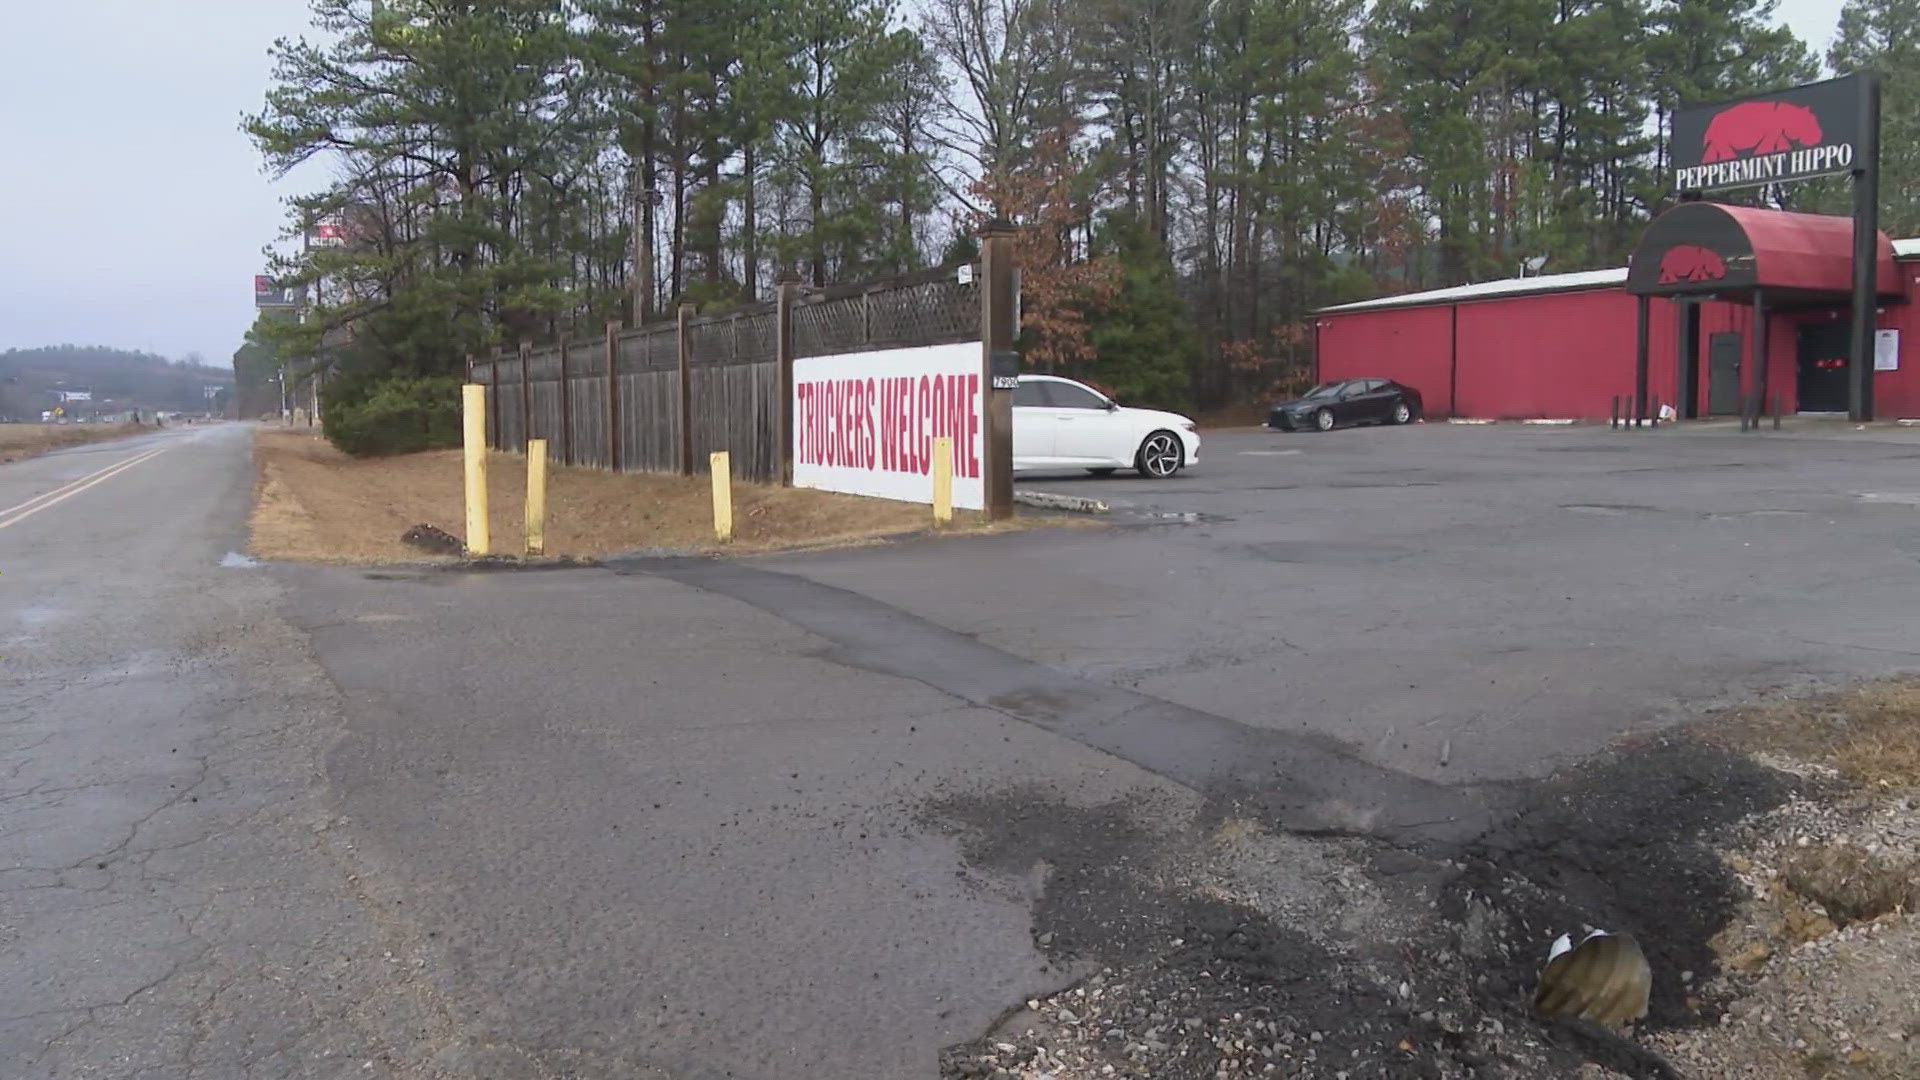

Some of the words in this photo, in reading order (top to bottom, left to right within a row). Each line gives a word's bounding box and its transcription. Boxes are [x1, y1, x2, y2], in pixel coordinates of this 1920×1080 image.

[1676, 153, 1786, 191] PEPPERMINT
[1791, 143, 1852, 174] HIPPO
[798, 377, 875, 471] TRUCKERS
[881, 373, 979, 478] WELCOME
